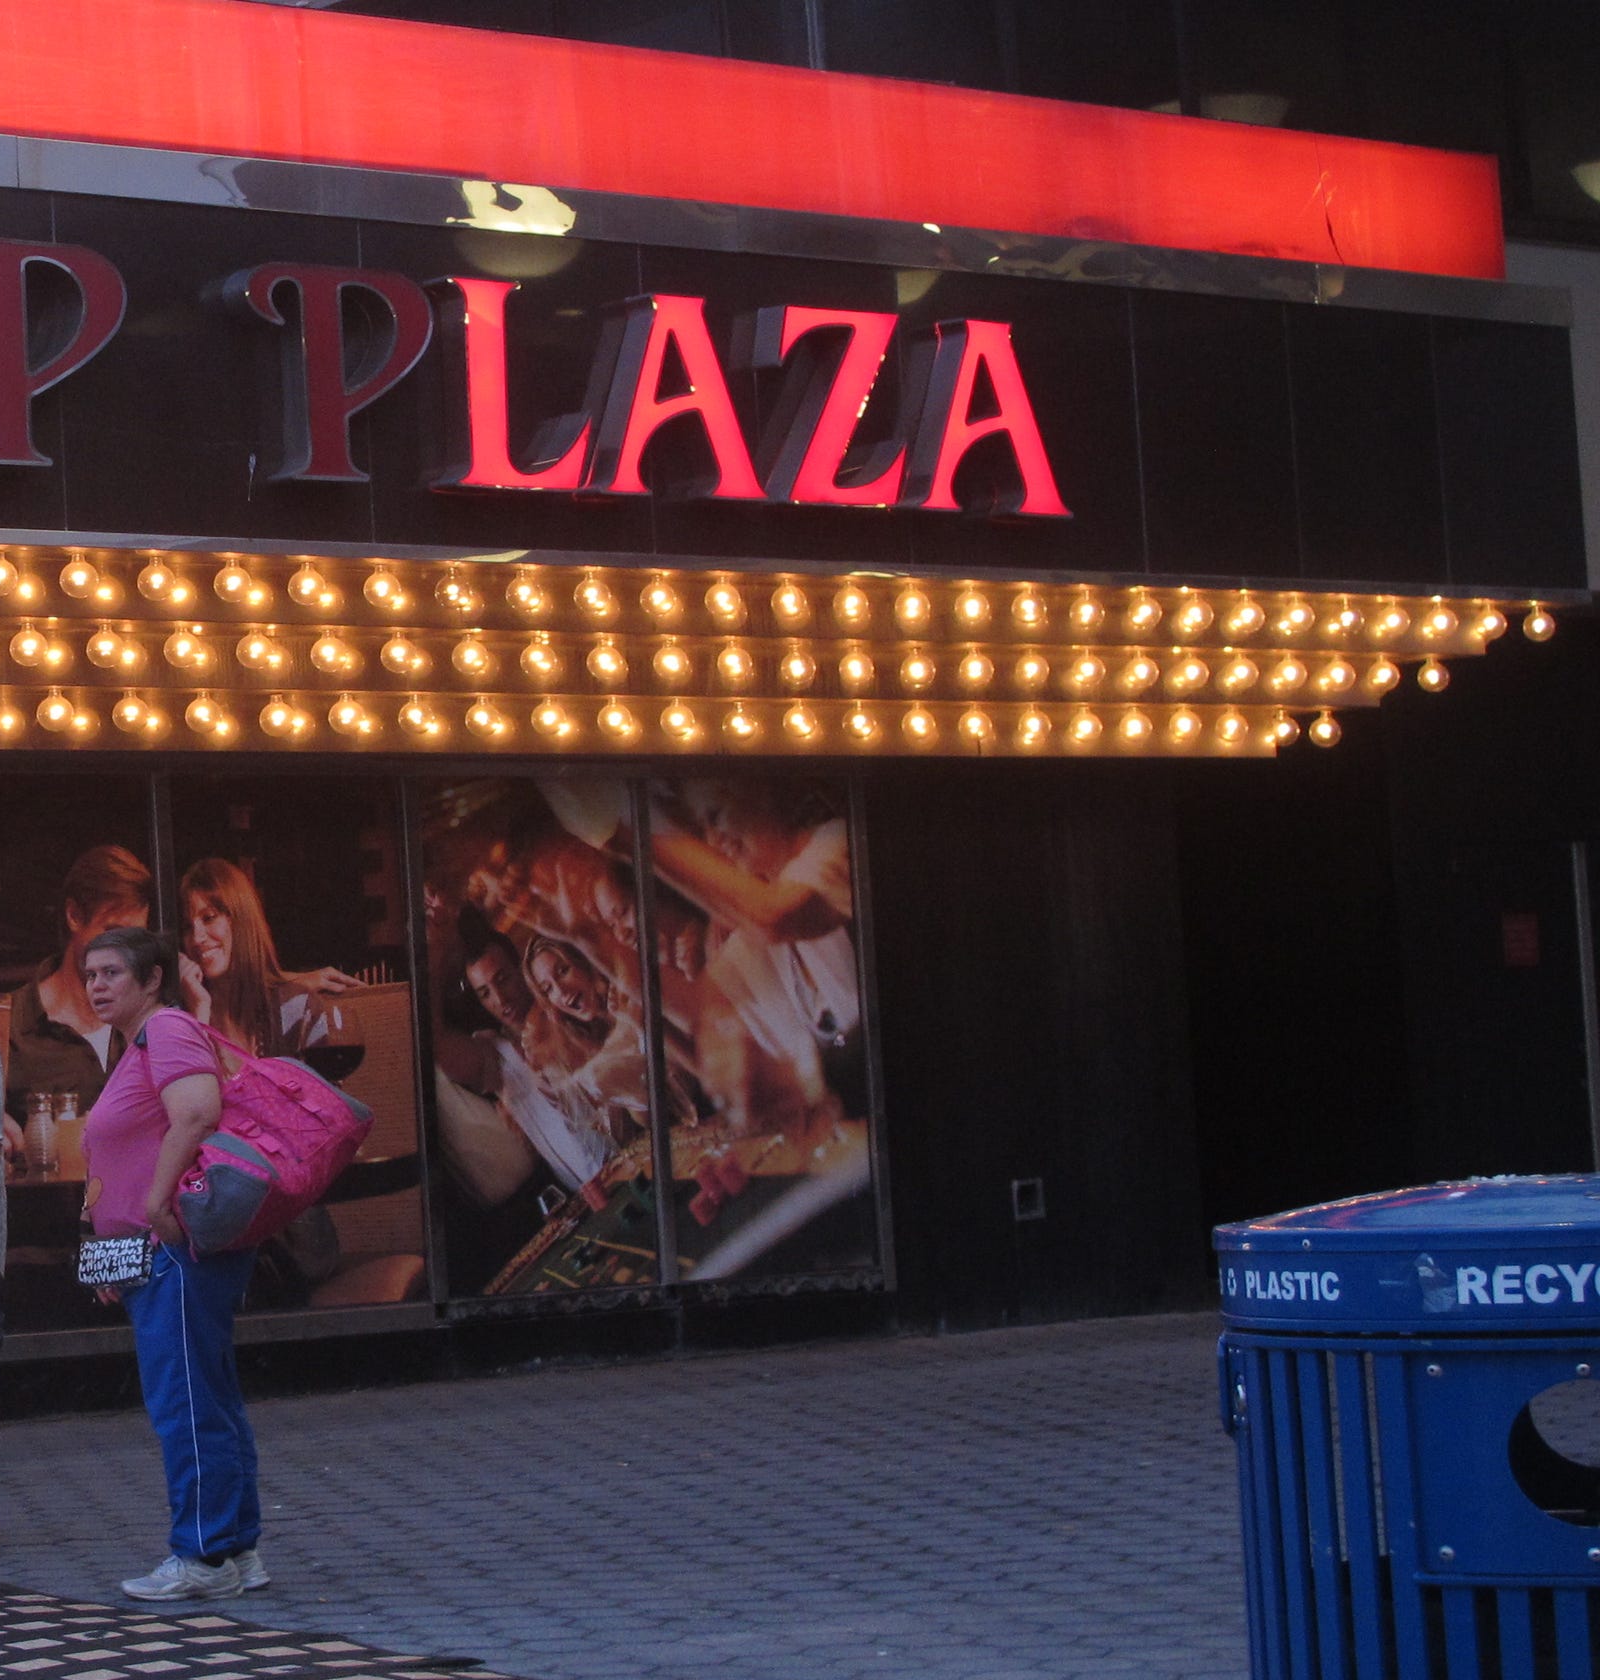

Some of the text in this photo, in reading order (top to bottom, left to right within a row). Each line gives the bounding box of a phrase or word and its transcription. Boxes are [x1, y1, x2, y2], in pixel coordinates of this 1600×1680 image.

[240, 262, 1074, 519] PLAZA
[1244, 1270, 1340, 1301] PLASTIC
[1456, 1263, 1600, 1305] RECY
